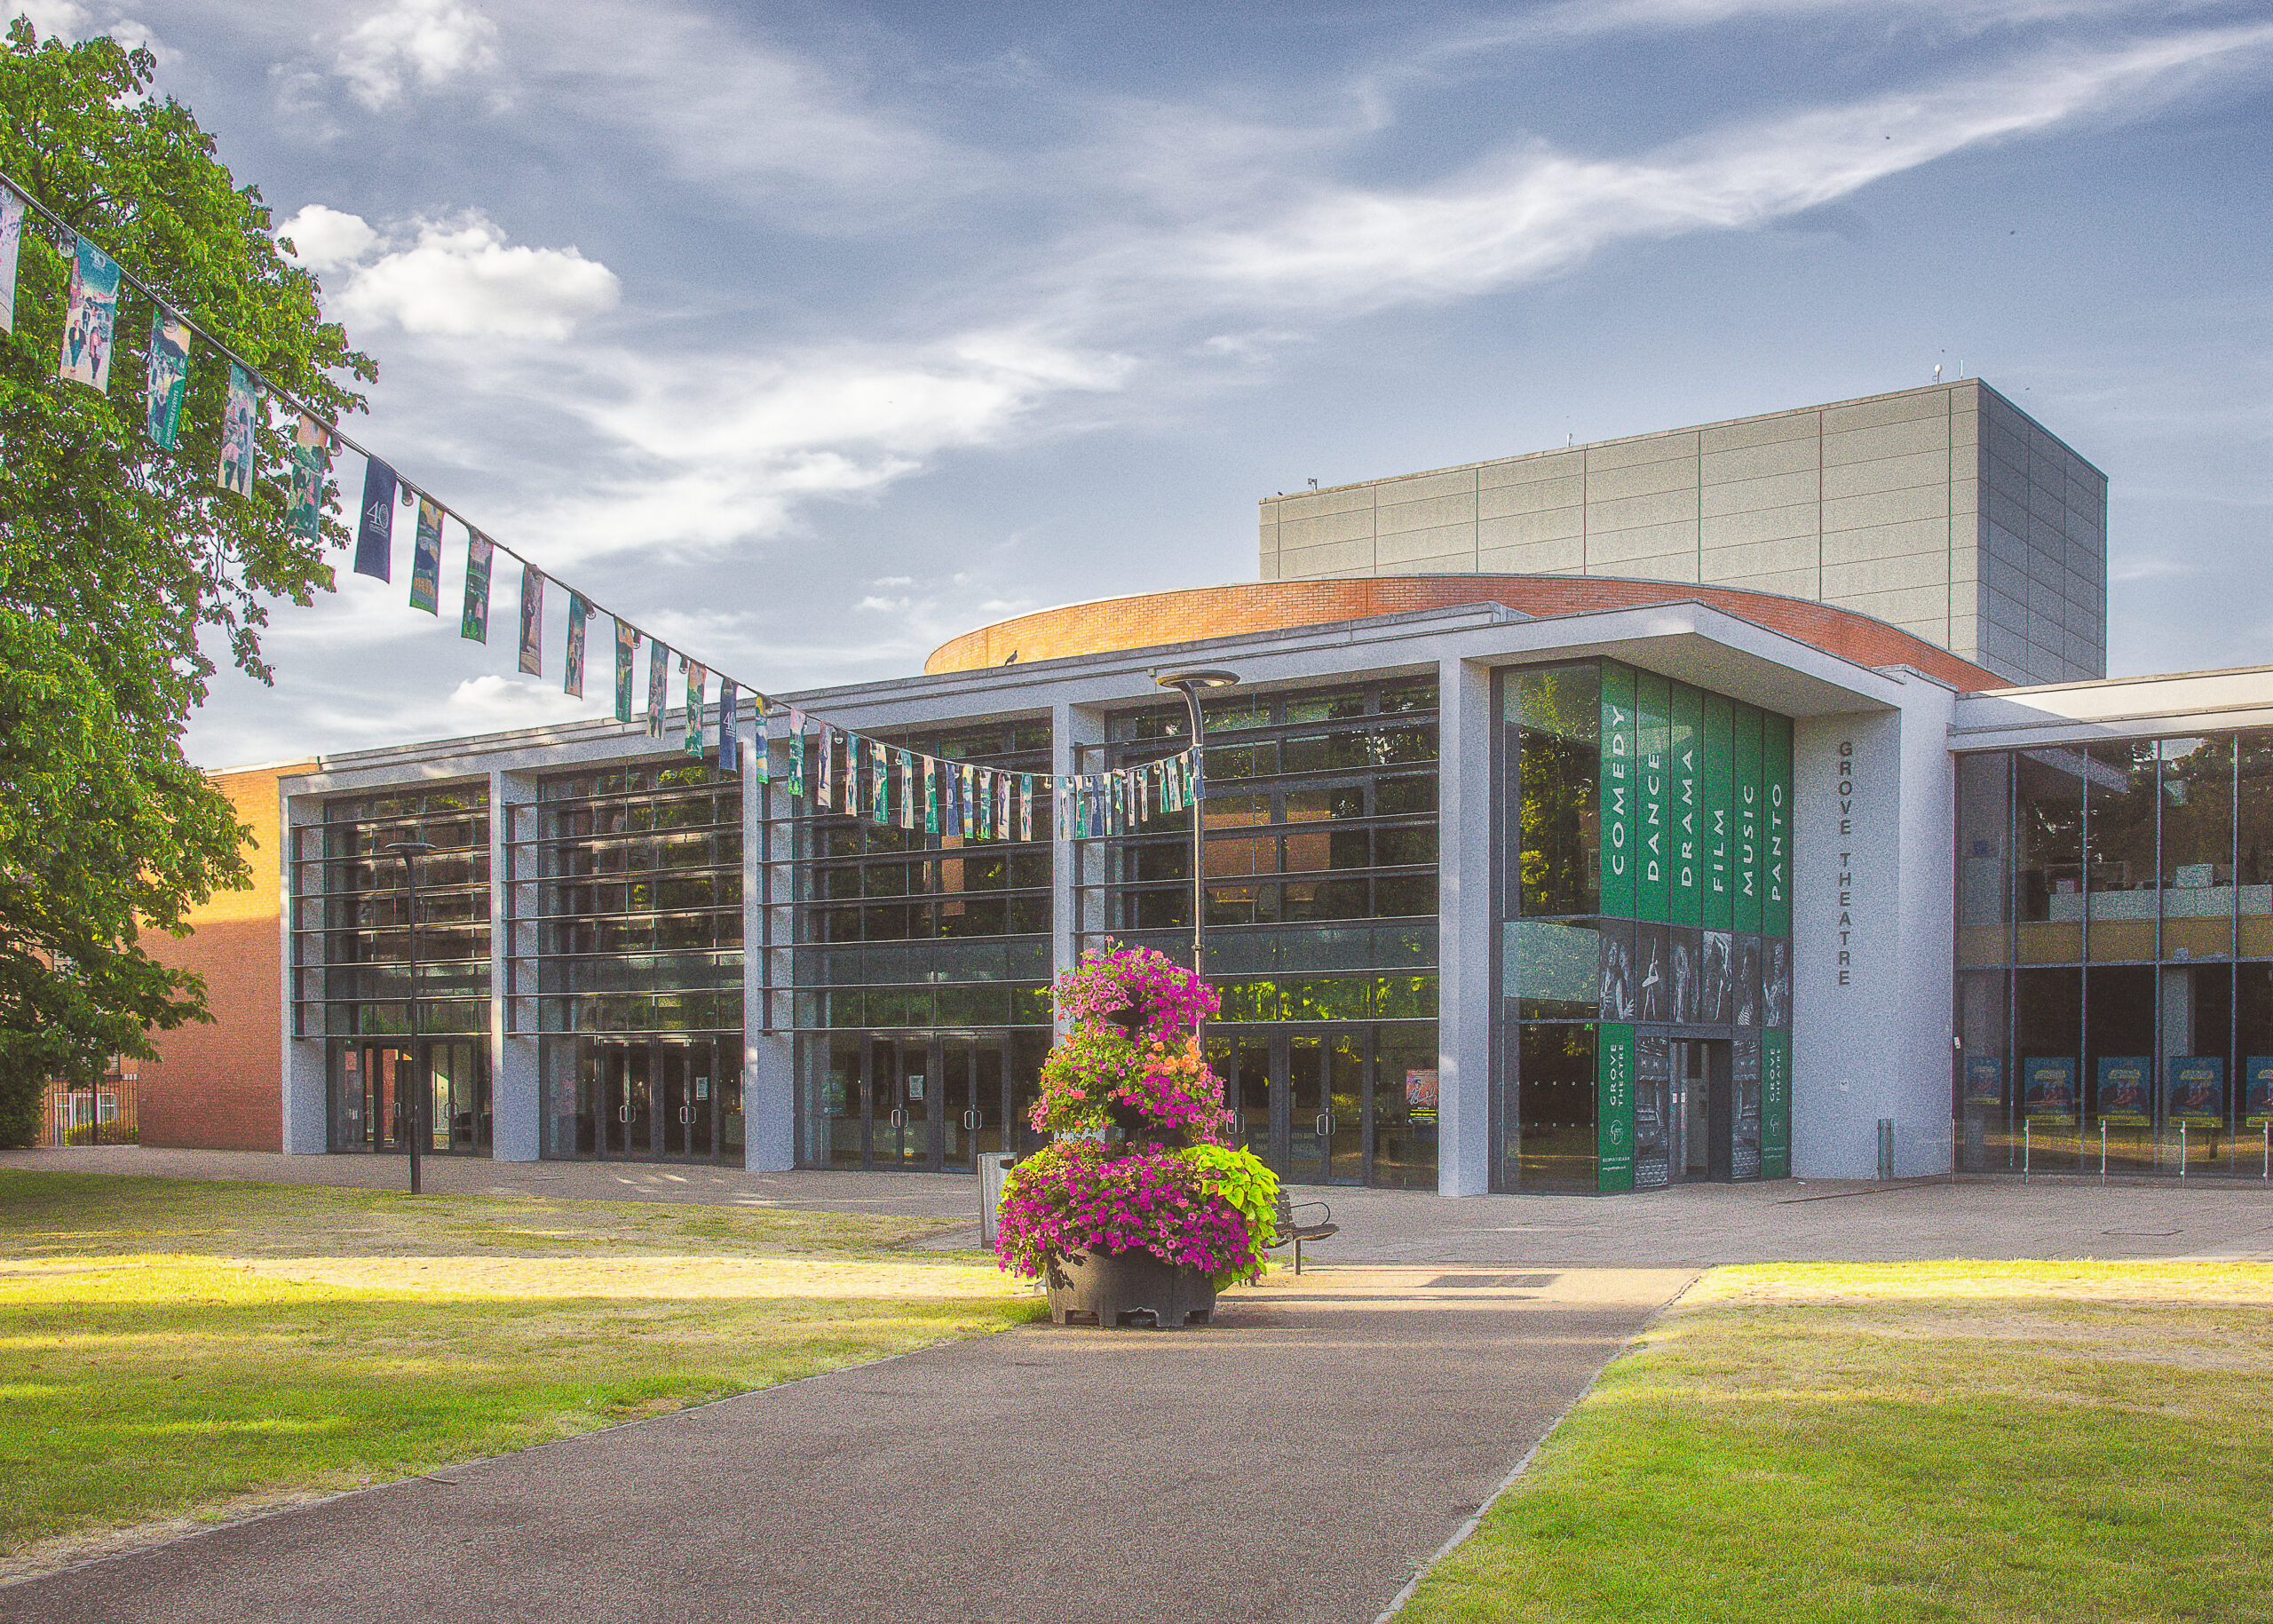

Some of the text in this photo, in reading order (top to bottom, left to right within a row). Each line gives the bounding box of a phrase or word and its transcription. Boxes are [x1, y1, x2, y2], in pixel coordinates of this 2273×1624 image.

[367, 501, 389, 529] 40
[1612, 706, 1625, 875] COMEDY
[1647, 753, 1659, 882] DANCE
[1681, 750, 1693, 887] DRAMA
[1713, 809, 1724, 892] FILM
[1743, 785, 1754, 897] MUSIC
[1771, 784, 1782, 901] PANTO
[1838, 741, 1853, 986] GROVE THEATRE
